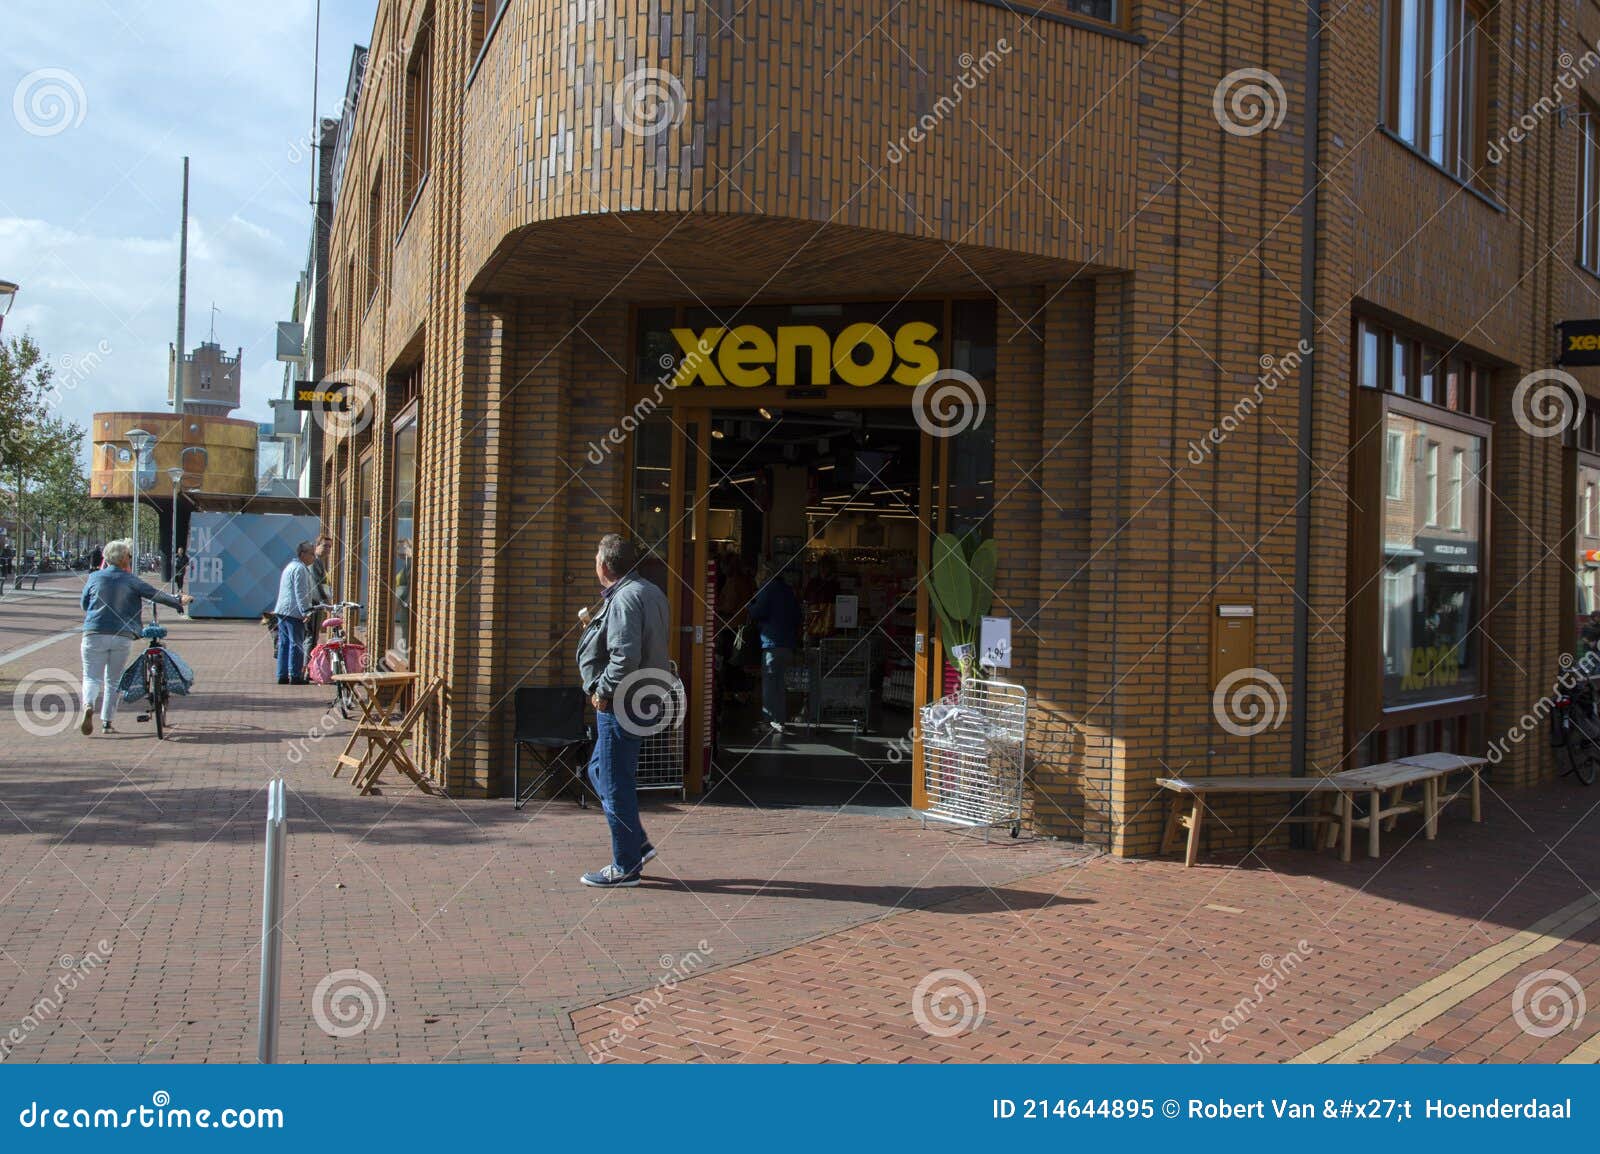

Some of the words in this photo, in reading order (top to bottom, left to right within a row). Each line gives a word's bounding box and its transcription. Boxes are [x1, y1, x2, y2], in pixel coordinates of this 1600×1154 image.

[1567, 335, 1600, 351] xe
[670, 321, 939, 387] xenos
[298, 390, 343, 403] xenos
